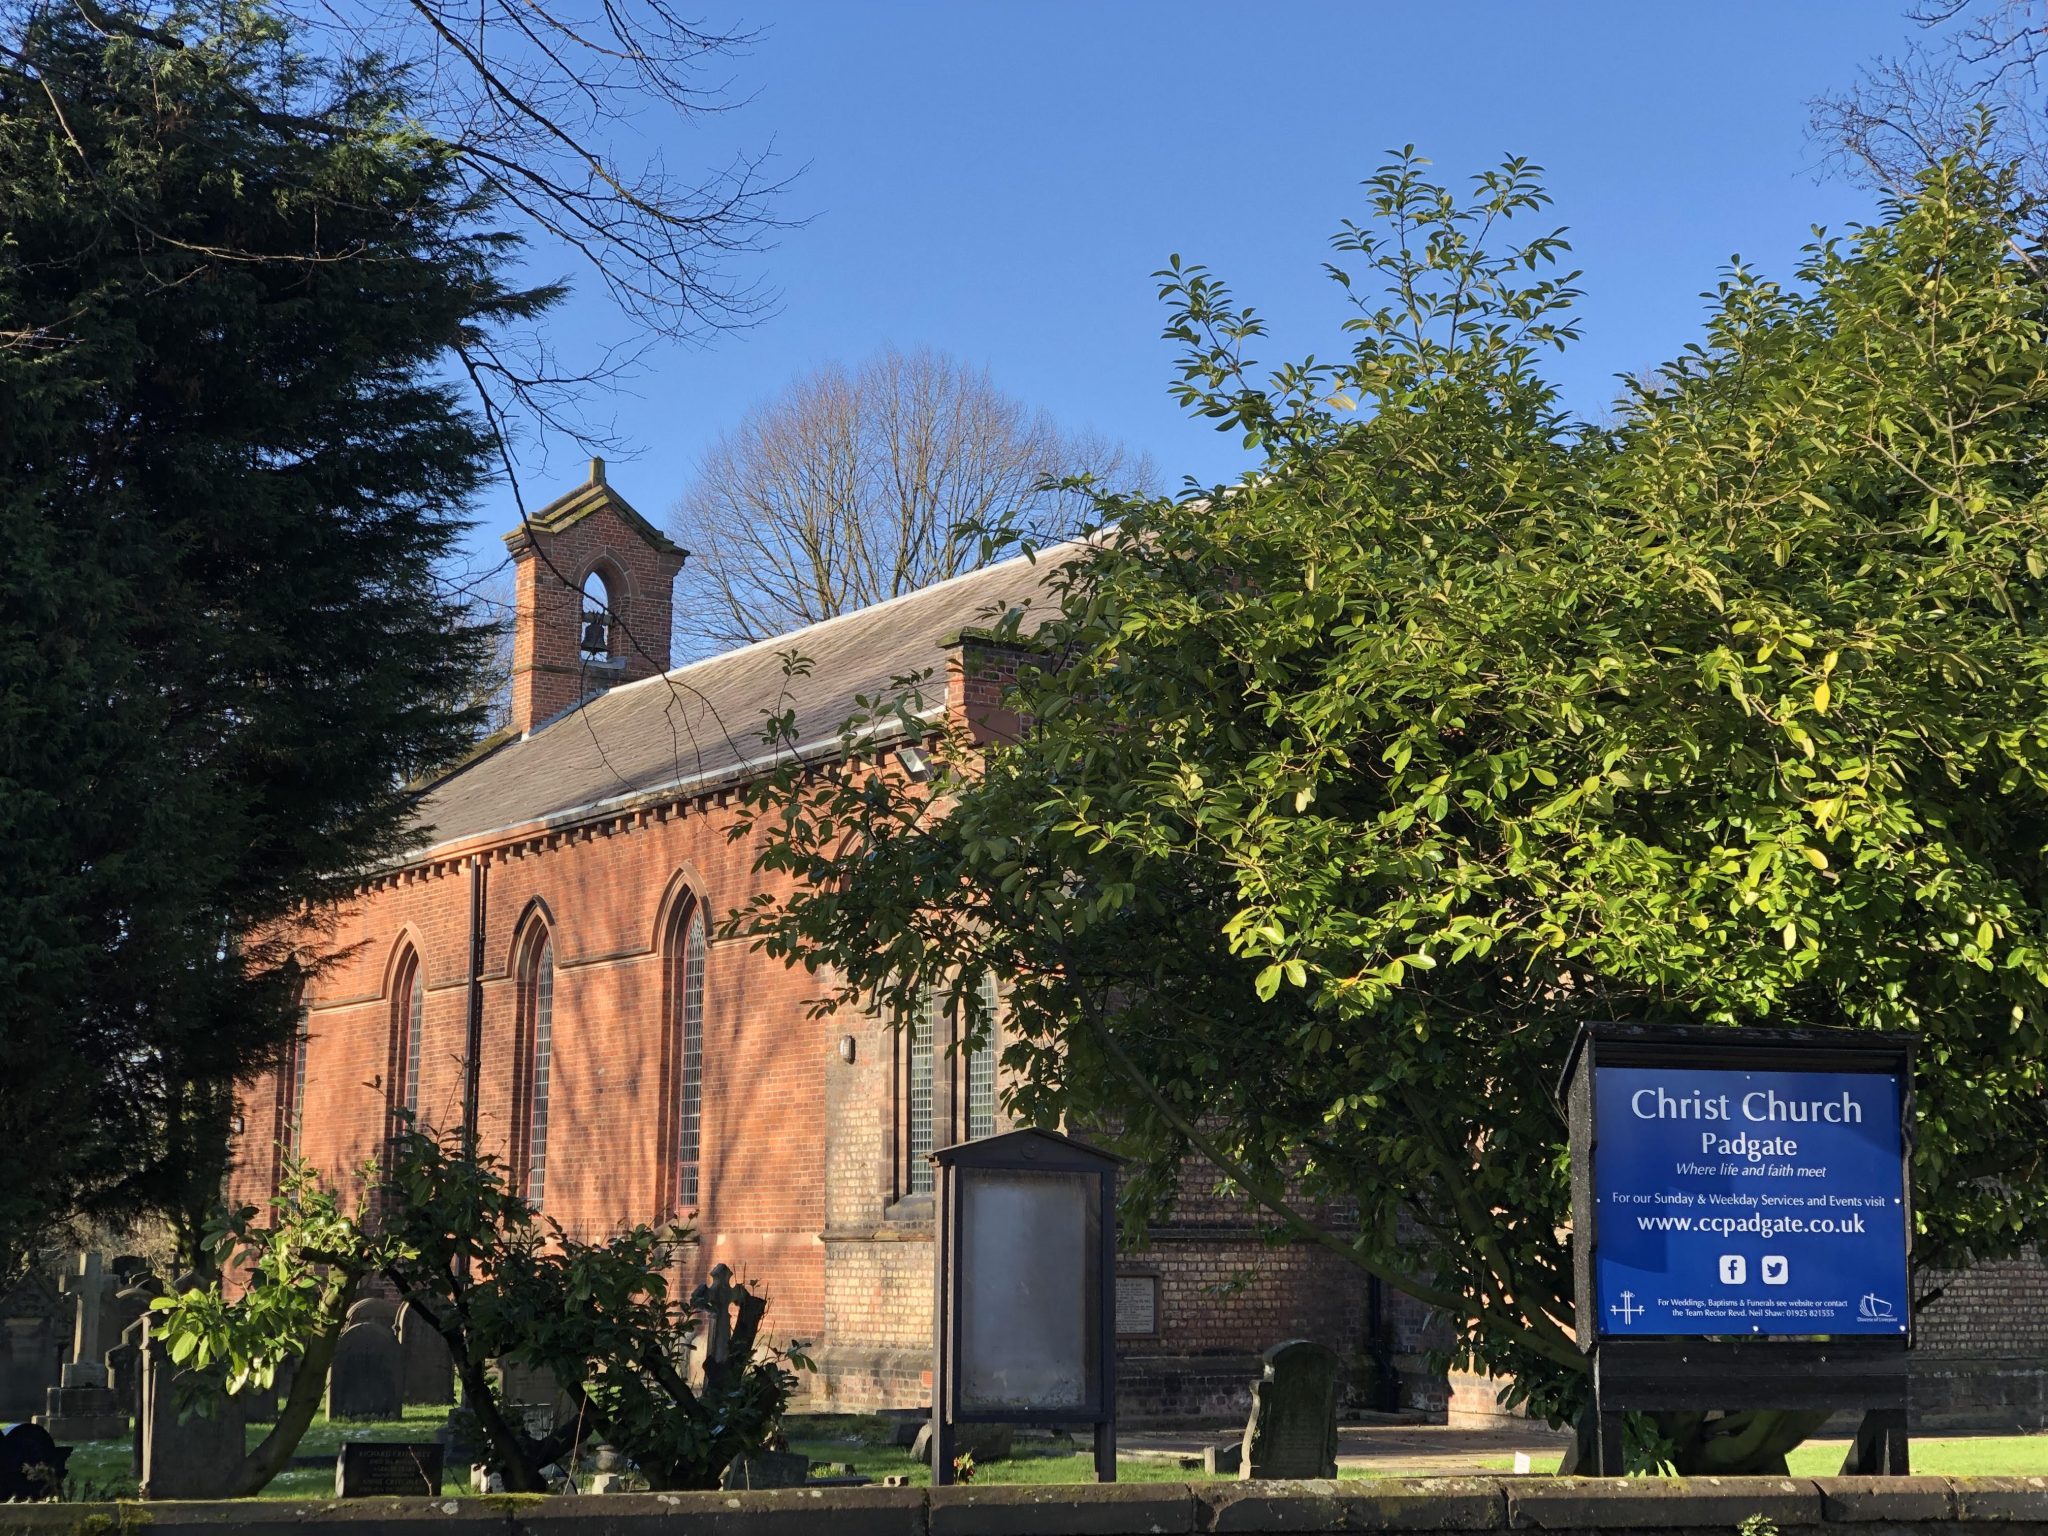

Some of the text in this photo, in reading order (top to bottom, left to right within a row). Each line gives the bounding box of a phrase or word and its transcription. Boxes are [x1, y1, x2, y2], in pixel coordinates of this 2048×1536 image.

[1632, 1087, 1861, 1122] Christ Church
[1702, 1132, 1797, 1162] Padgate
[1677, 1162, 1826, 1177] Where life and faith meet
[1613, 1192, 1885, 1208] For our Sunday & Weekday Services and Events visit
[1637, 1212, 1865, 1238] www.ccpadgate.co.uk
[1658, 1298, 1669, 1306] For
[1671, 1299, 1706, 1308] Weddings,
[1708, 1299, 1737, 1308] Baptisms
[1740, 1299, 1745, 1307] &
